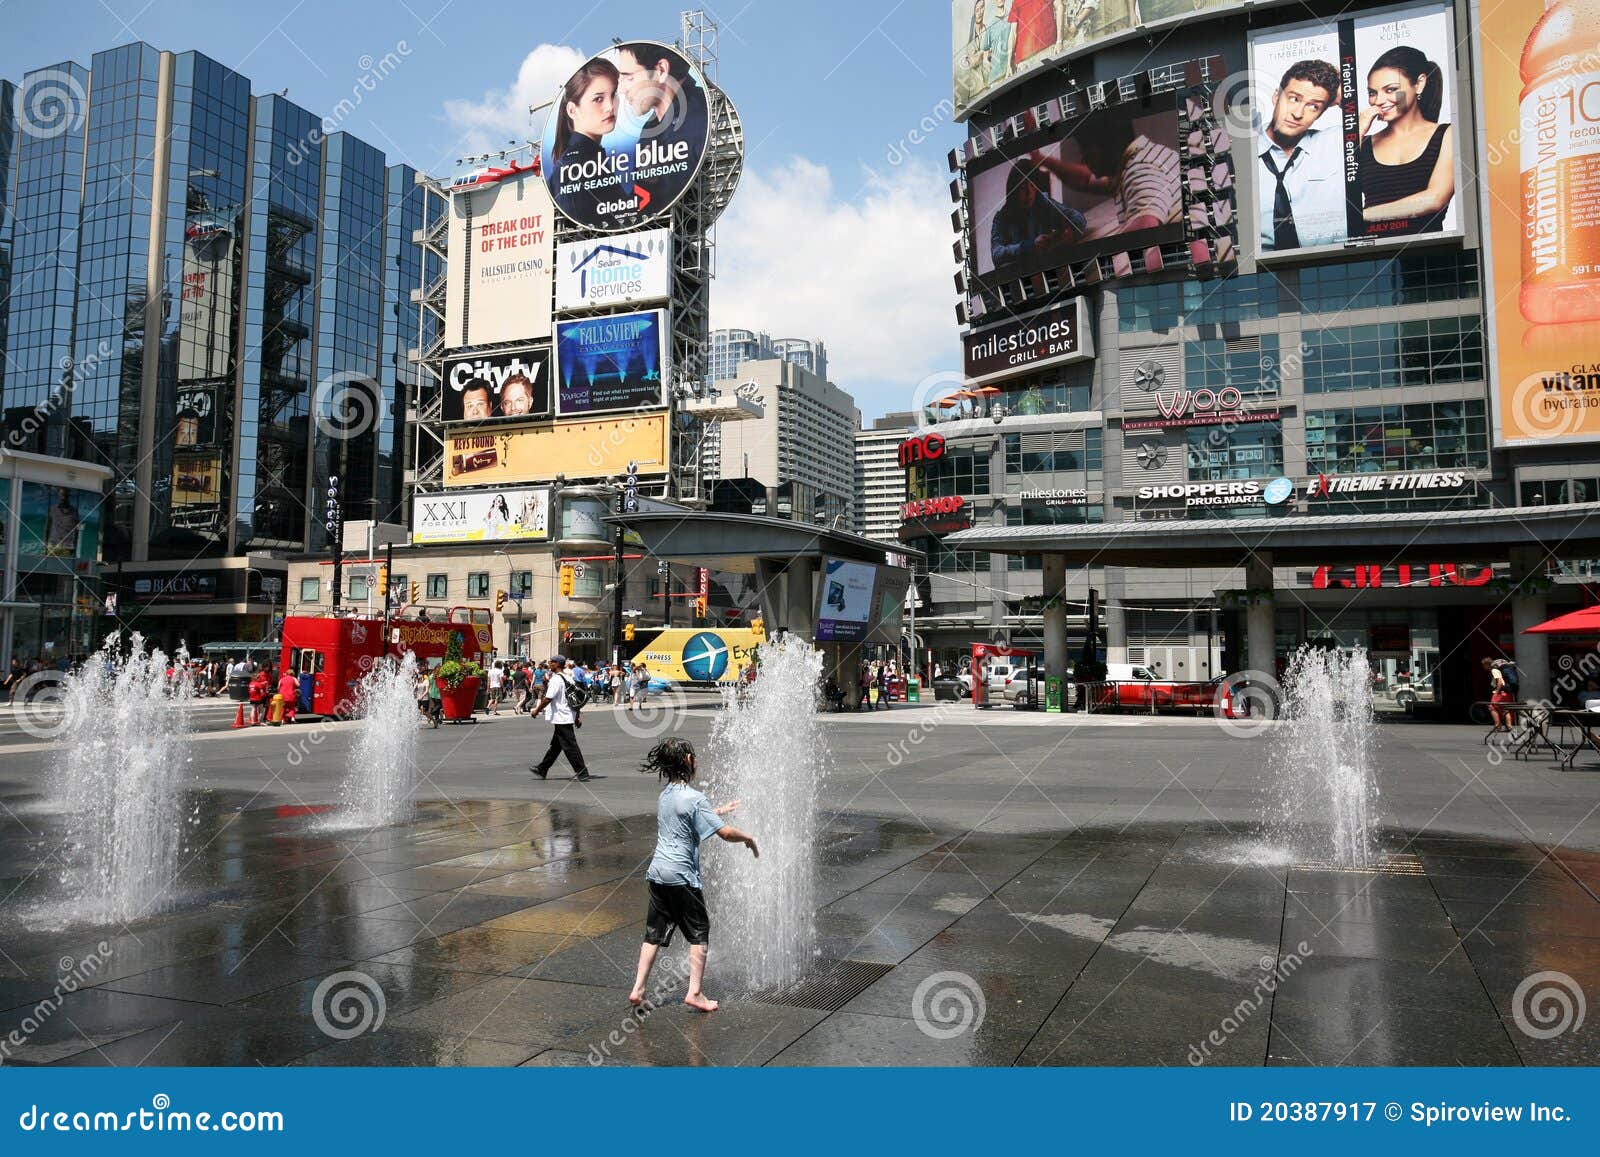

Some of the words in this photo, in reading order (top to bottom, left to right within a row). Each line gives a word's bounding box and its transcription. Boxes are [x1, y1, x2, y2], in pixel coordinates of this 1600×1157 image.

[1379, 32, 1411, 41] KUNIS
[1382, 23, 1407, 33] MILA
[1269, 45, 1329, 60] TIMBERLAKE
[1280, 39, 1315, 51] JUSTIN
[1342, 56, 1354, 99] Friends
[1344, 101, 1357, 130] With
[559, 150, 629, 183] rookie
[635, 140, 689, 168] blue
[1346, 133, 1359, 182] Benefits
[560, 182, 581, 195] NEW
[584, 175, 622, 190] SEASON
[631, 161, 688, 181] THURSDAYS
[596, 196, 638, 215] Global
[482, 221, 517, 237] BREAK
[520, 215, 542, 230] OUT
[1367, 222, 1388, 233] JULY
[482, 240, 495, 253] OF
[497, 235, 518, 250] THE
[520, 231, 545, 246] CITY
[481, 263, 517, 278] FALLSVIEW
[517, 258, 543, 273] CASINO
[598, 258, 622, 268] Sears
[590, 263, 643, 285] home
[589, 280, 643, 299] services
[579, 320, 641, 346] FALLSVIEW
[972, 319, 1071, 361] milestones
[1009, 349, 1038, 364] GRILL
[1049, 340, 1071, 354] BAR
[1155, 386, 1242, 419] WOO
[1543, 394, 1600, 412] hydratio
[454, 438, 469, 451] KEYS
[1019, 488, 1086, 499] milestones
[1139, 481, 1259, 499] SHOPPERS
[1306, 471, 1386, 499] EXTREME
[1390, 471, 1465, 490] FITNESS
[924, 495, 964, 515] SHOP
[1187, 497, 1221, 506] DRUG
[1224, 495, 1259, 505] MART
[423, 501, 467, 522] XXI
[421, 520, 468, 528] FOREVER
